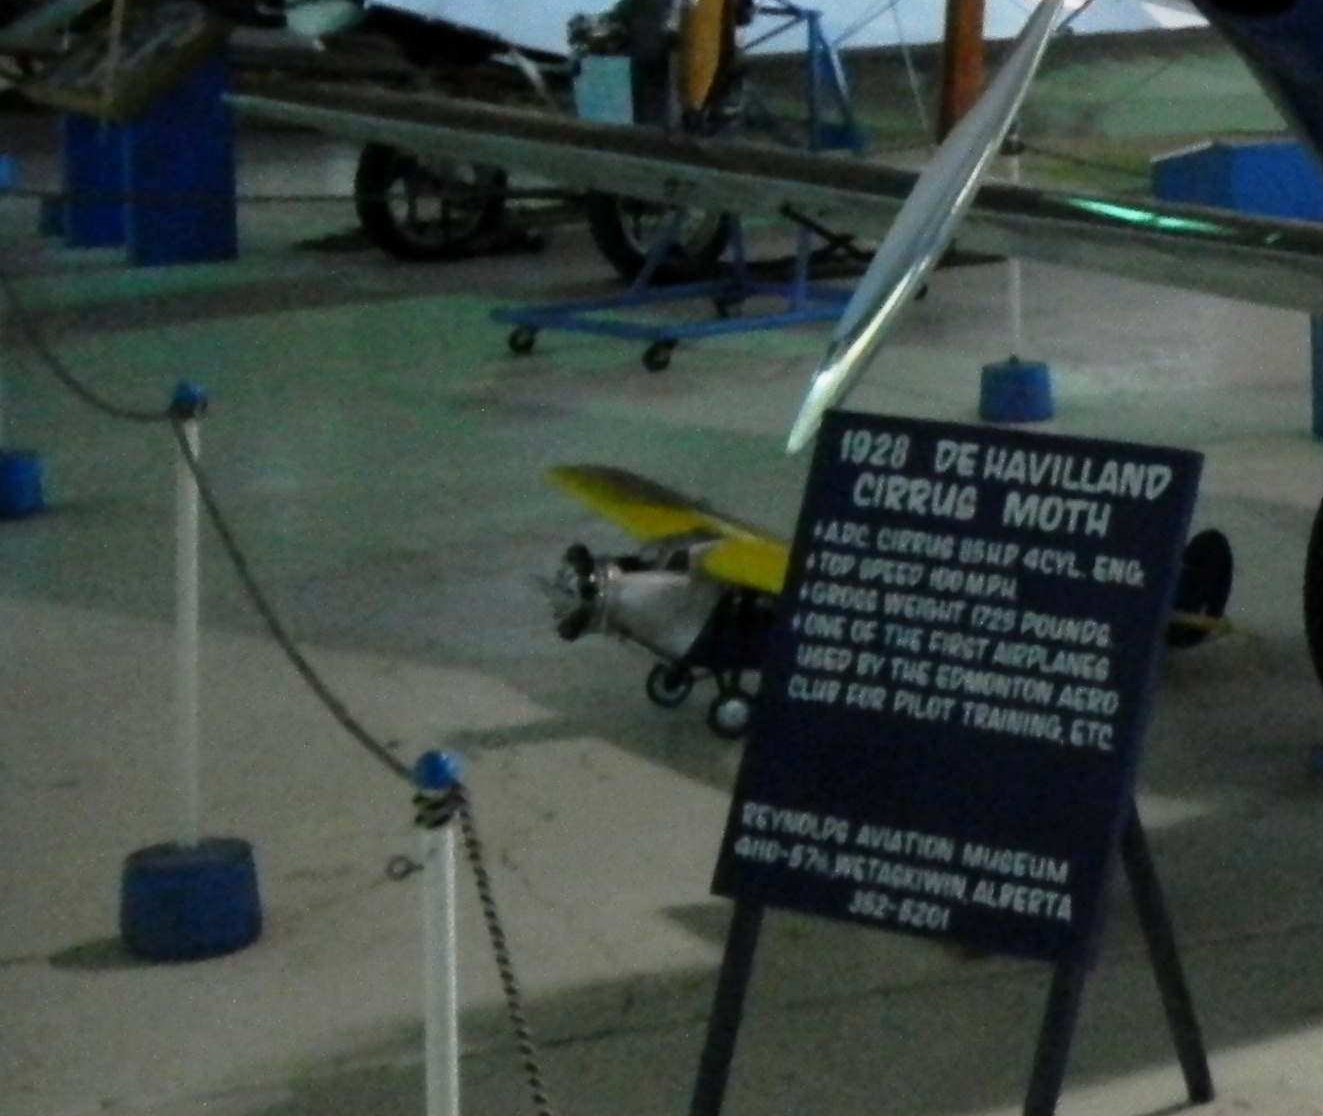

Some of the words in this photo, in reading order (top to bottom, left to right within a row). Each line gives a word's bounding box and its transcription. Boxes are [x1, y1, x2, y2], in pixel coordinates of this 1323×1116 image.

[840, 429, 911, 469] 1928
[933, 438, 979, 477] DE
[983, 445, 1172, 502] HAVILLAND
[853, 471, 978, 521] CIRRUS
[1002, 491, 1112, 538] MOTH
[819, 550, 855, 577] TOP
[858, 556, 925, 586] SPEED
[876, 526, 955, 560] CIRRUS
[811, 580, 879, 612] GROSS
[883, 591, 967, 624] WEIGHT
[804, 610, 847, 640] ONE
[850, 618, 879, 644] OF
[884, 622, 925, 652] THE
[929, 629, 991, 661] FIRST
[991, 640, 1110, 683] AIRPLANES
[787, 673, 842, 705] CLUB
[845, 683, 888, 712] FOR
[893, 689, 957, 722] PILOT
[797, 644, 852, 673] USED
[856, 651, 886, 677] BY
[891, 656, 933, 687] THE
[935, 663, 1055, 706] EDMONTON
[1057, 683, 1120, 716] AERO
[742, 801, 849, 845] REYNOLDS
[855, 824, 954, 863] AVIATION
[962, 841, 1070, 885] MUSEUM
[971, 878, 1072, 923] ALBERTA
